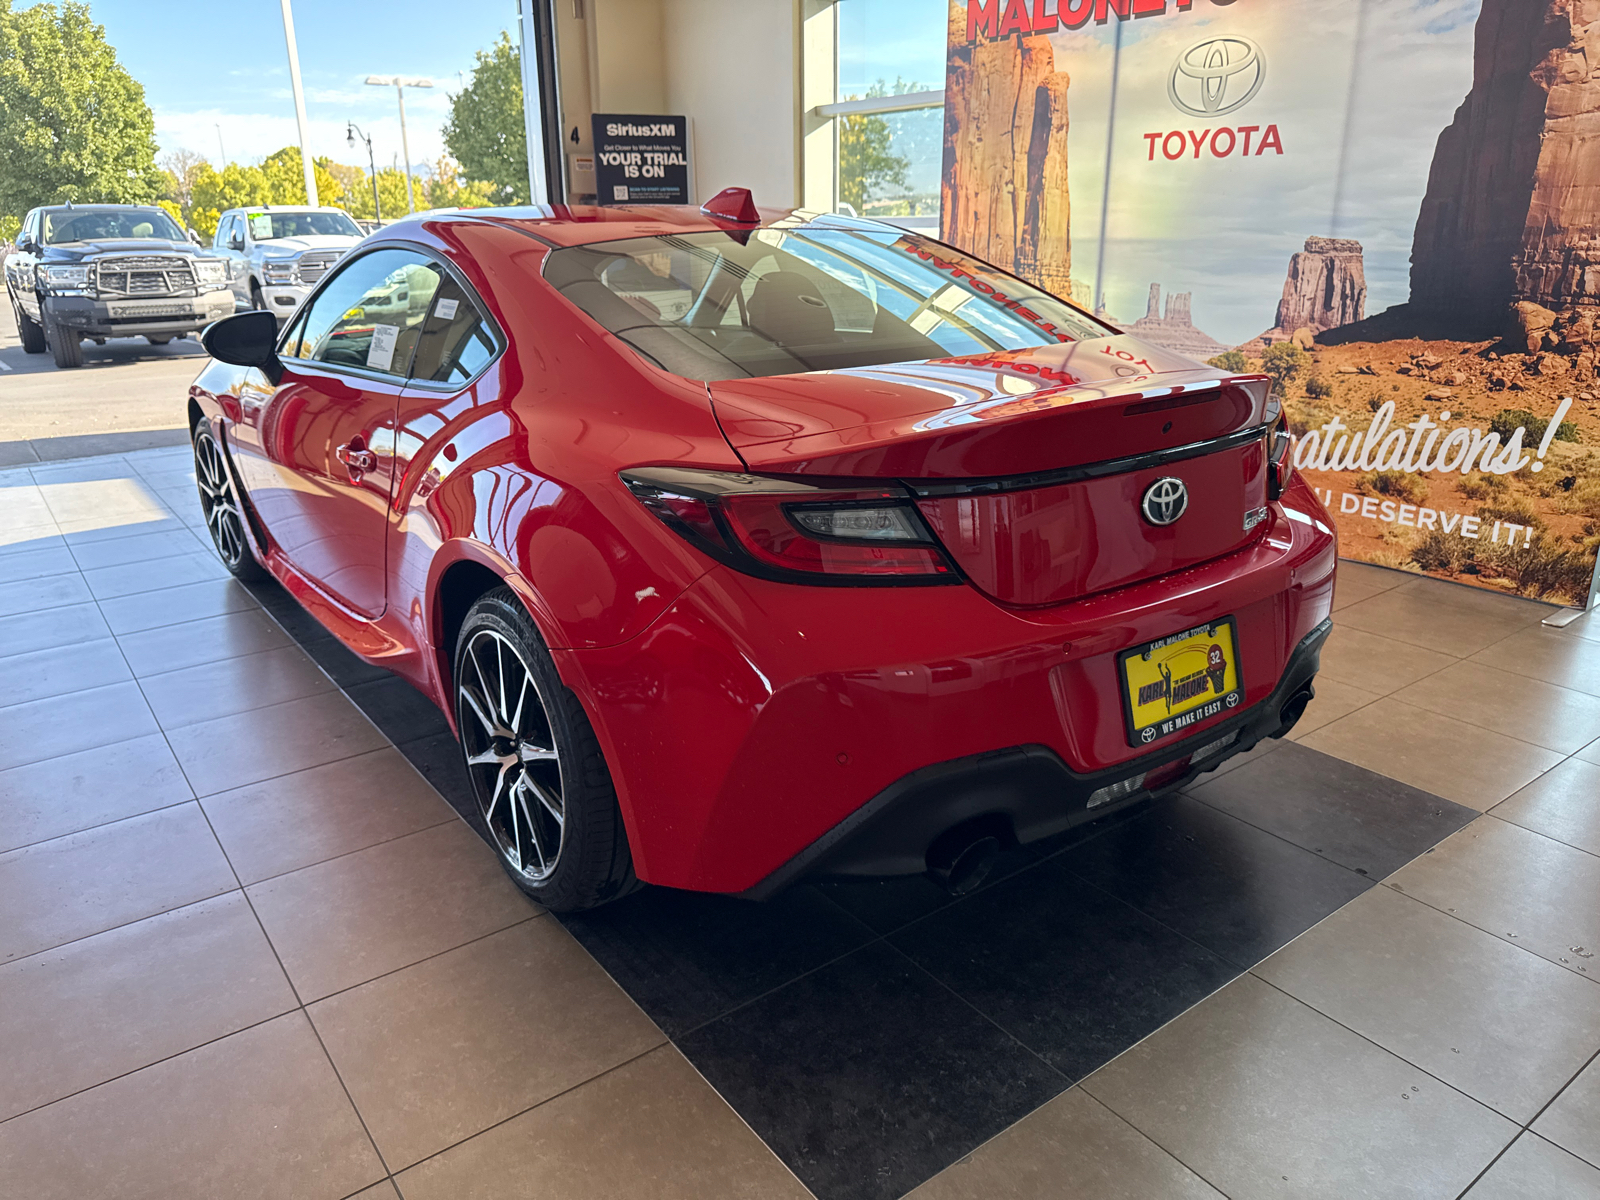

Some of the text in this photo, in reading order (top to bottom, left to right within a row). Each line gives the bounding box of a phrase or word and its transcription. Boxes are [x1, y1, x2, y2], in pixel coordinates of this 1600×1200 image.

[570, 126, 580, 145] 4
[606, 123, 676, 137] SiriusXM
[653, 144, 671, 152] Moves
[1143, 124, 1284, 161] TOYOTA
[599, 152, 642, 166] YOUR
[643, 152, 687, 166] TRIAL
[624, 165, 665, 178] IS ON
[1291, 397, 1573, 475] atulations!
[1340, 493, 1481, 540] DESERVE
[1491, 521, 1534, 549] IT!
[1149, 624, 1210, 651] KARL MALONE TOYOTA
[1210, 650, 1221, 665] 32
[1137, 680, 1166, 707] KARL
[1172, 674, 1209, 706] MALONE
[1161, 701, 1221, 734] WE MAKE IT EASY
